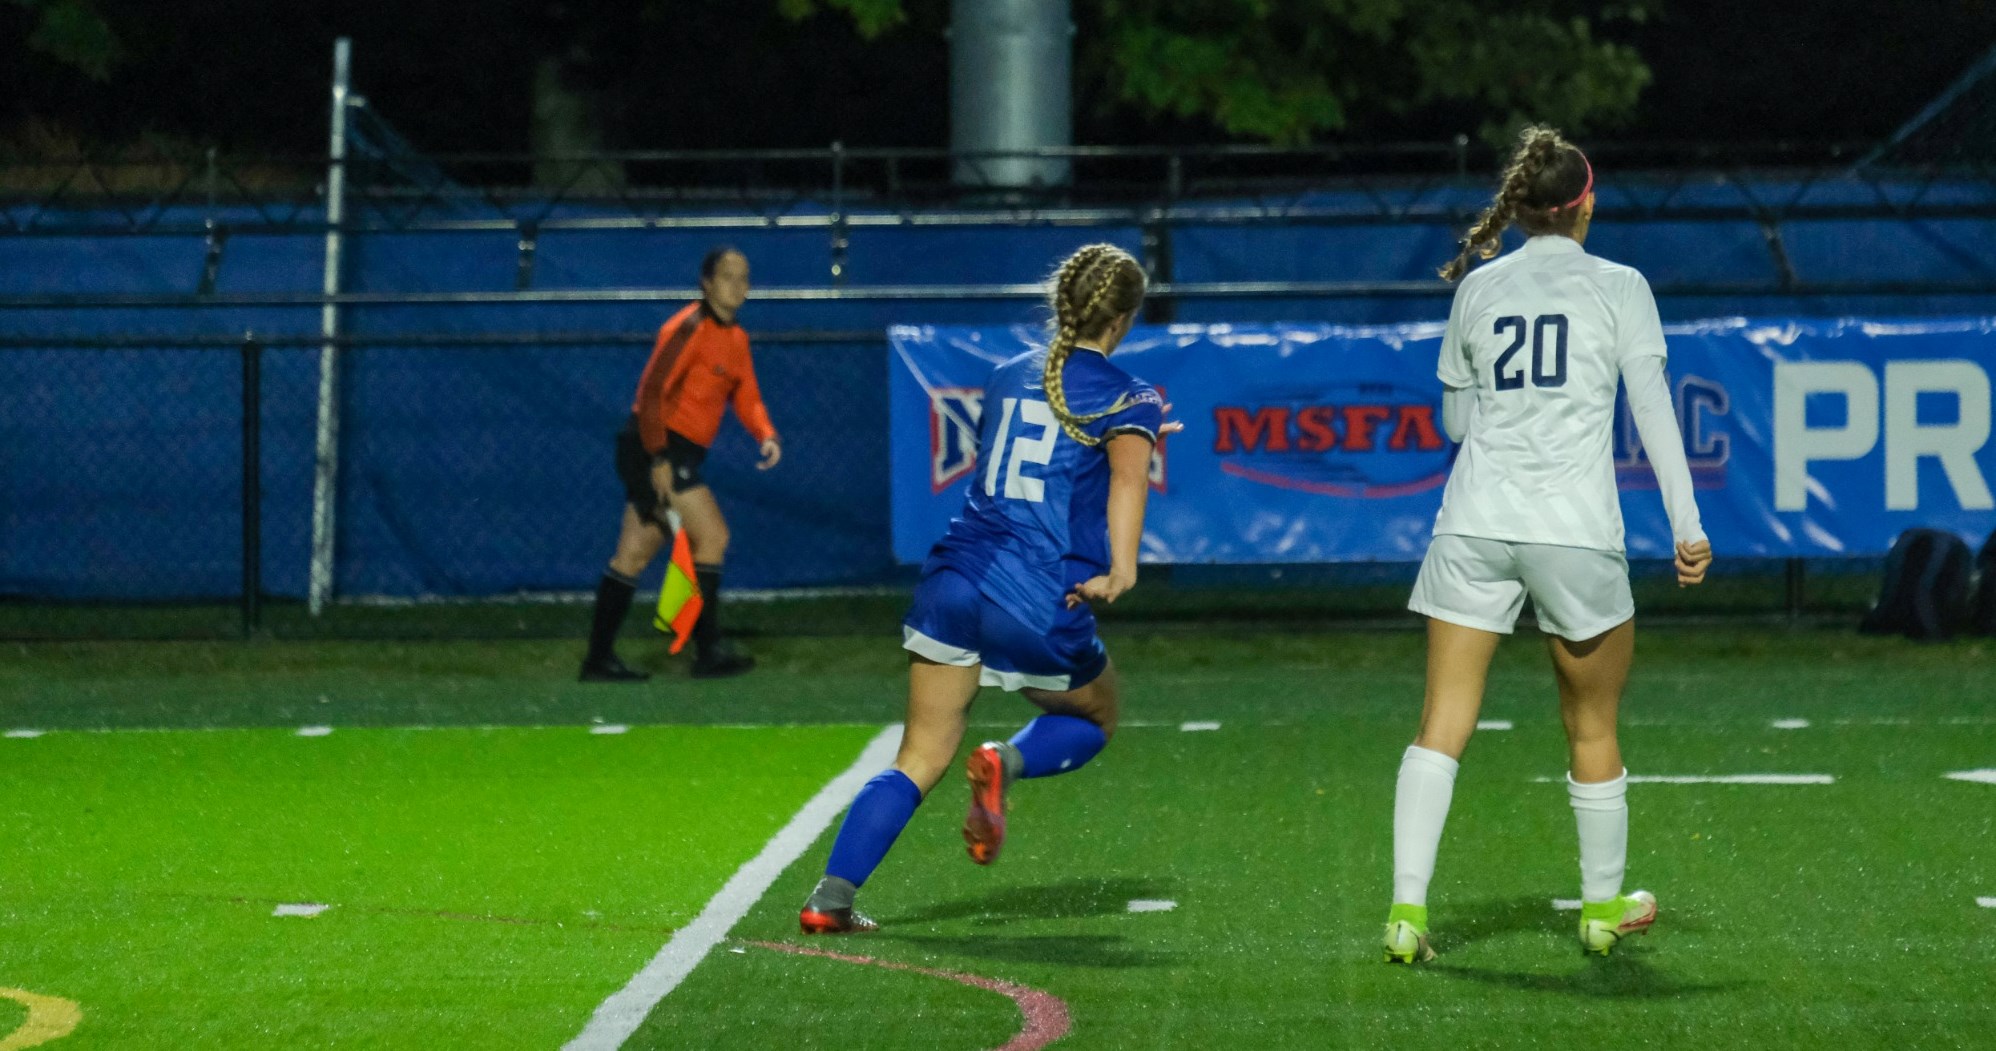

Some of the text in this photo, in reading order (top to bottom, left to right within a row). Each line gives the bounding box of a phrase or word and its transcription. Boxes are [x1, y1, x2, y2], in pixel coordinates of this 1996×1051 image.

[1493, 314, 1568, 391] 20
[985, 398, 1060, 502] 12
[1213, 406, 1443, 451] MSFA
[1774, 360, 1995, 511] PR
